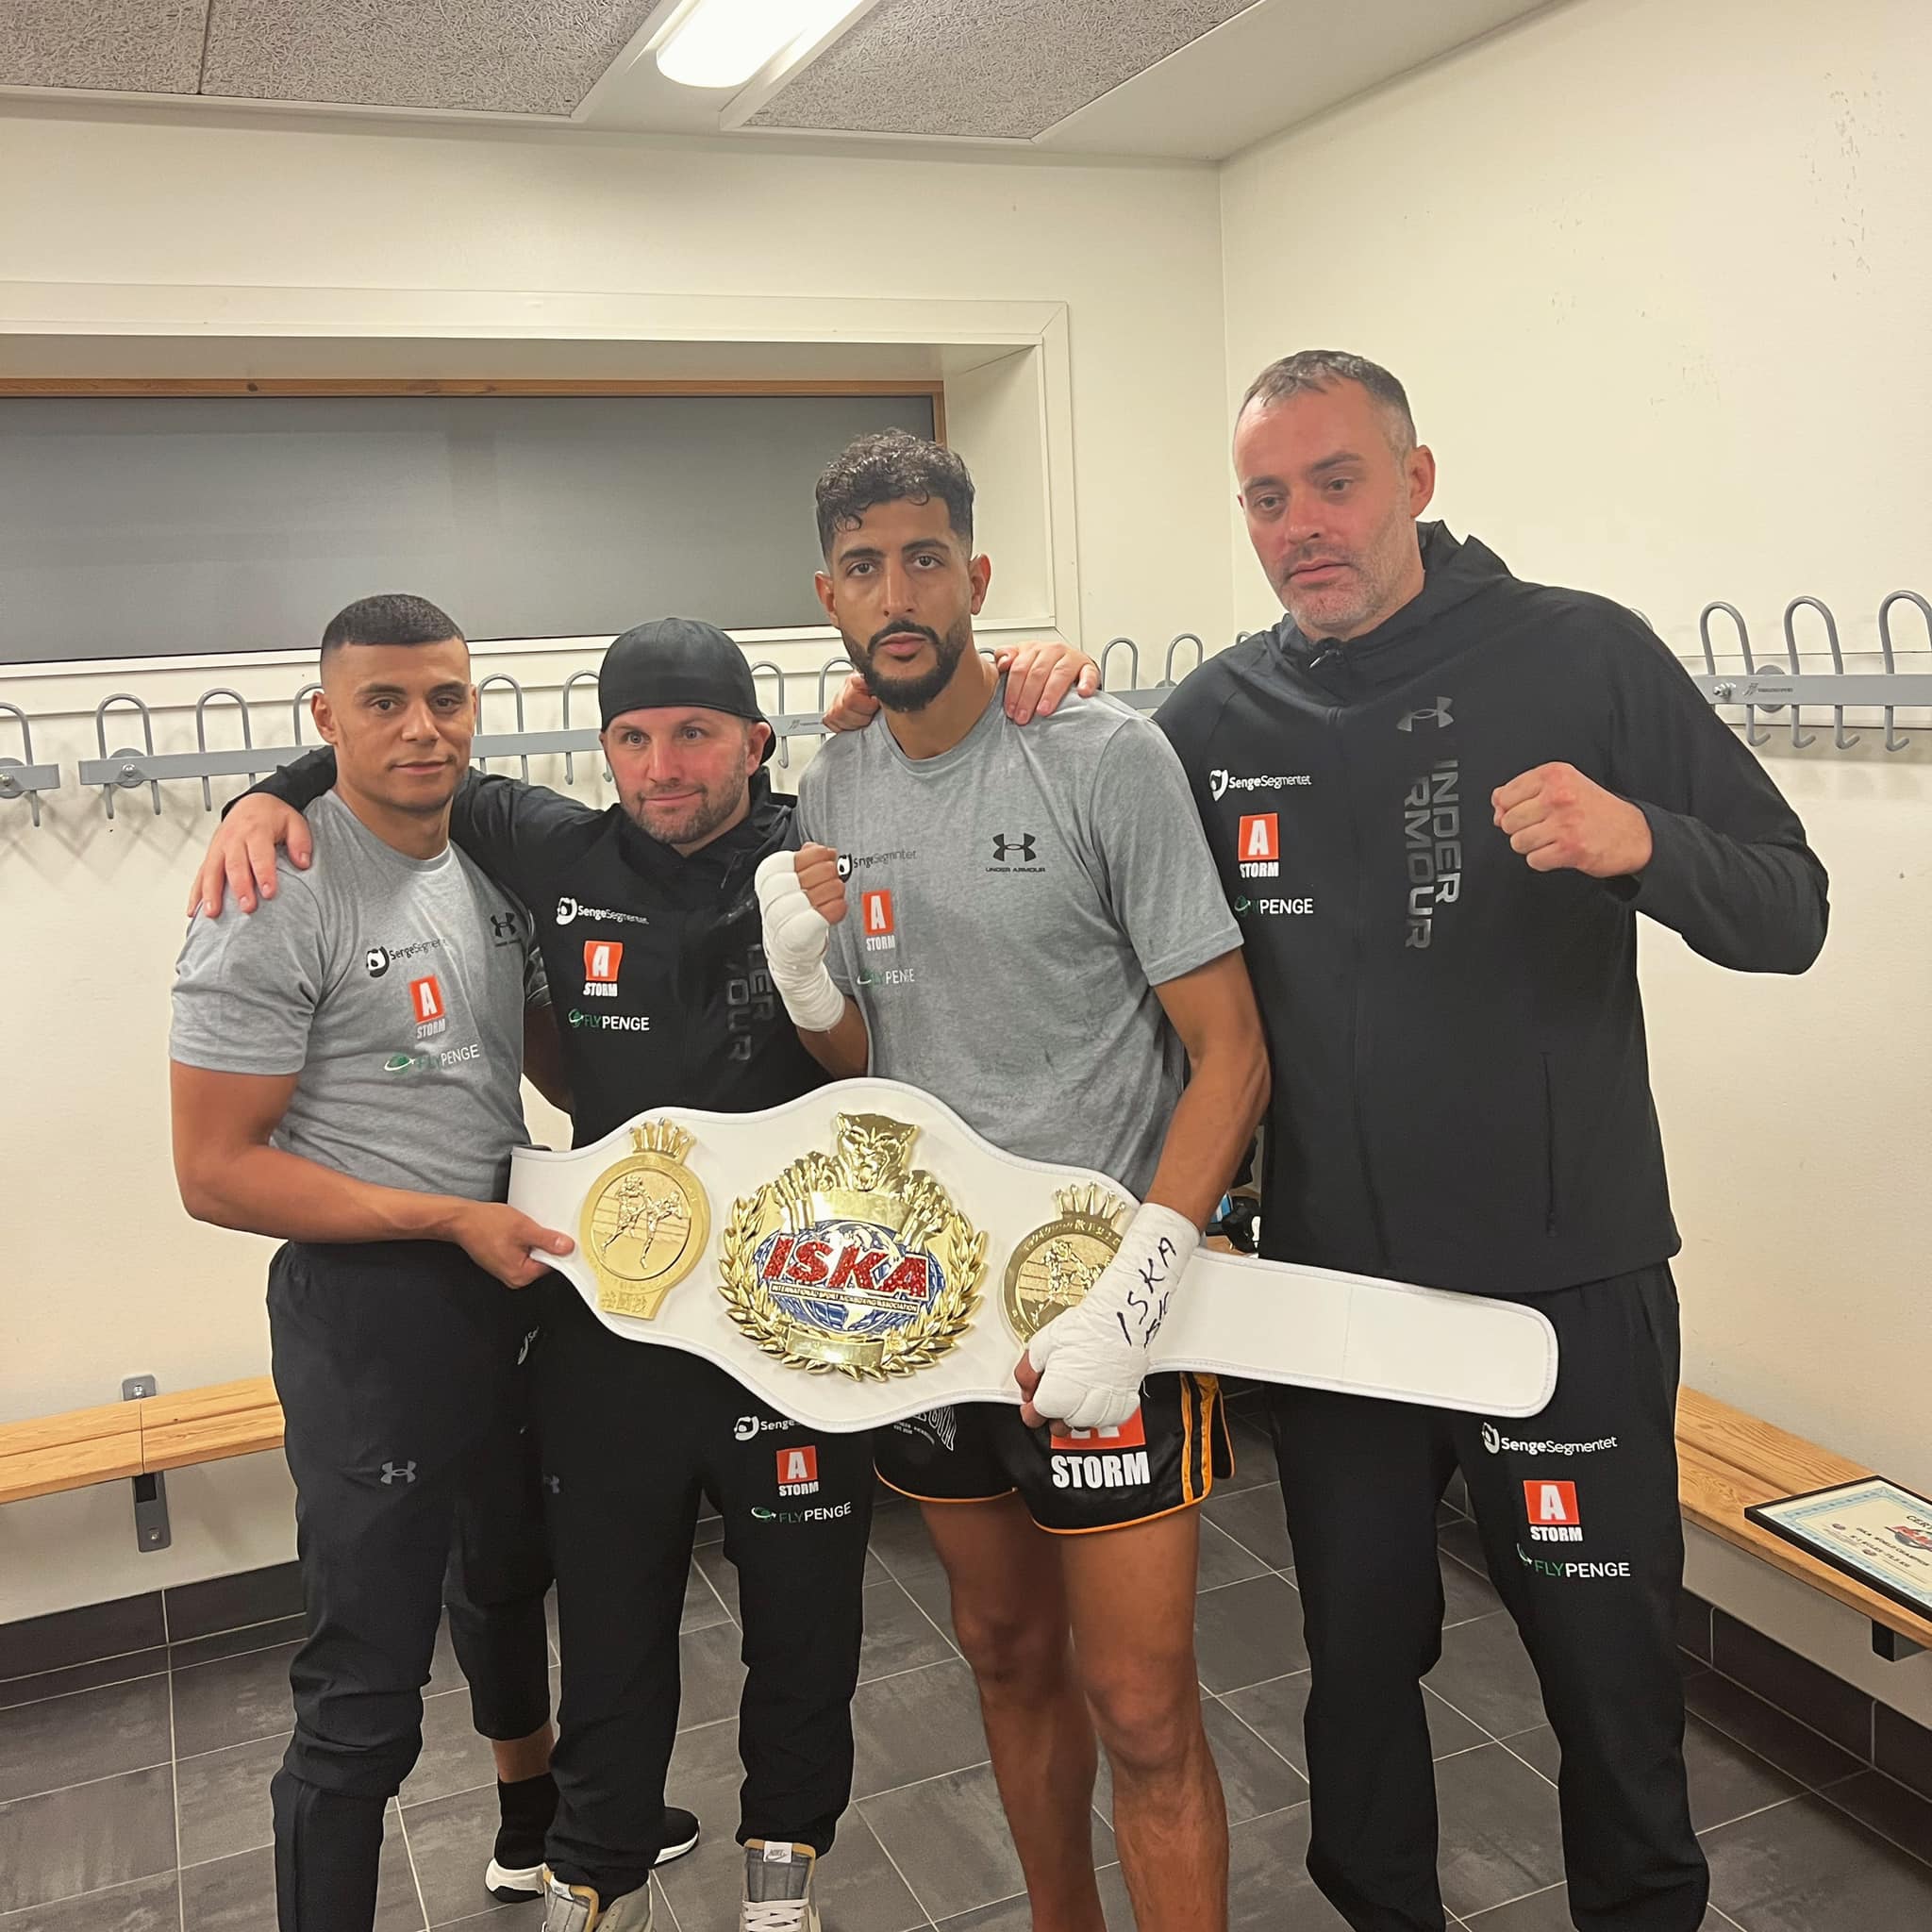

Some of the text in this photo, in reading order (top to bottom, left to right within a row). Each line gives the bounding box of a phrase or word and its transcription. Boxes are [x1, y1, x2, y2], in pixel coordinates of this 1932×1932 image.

[1228, 774, 1313, 791] SengeSegmentet
[1248, 819, 1270, 857] A
[1240, 861, 1279, 878] STORM
[1404, 775, 1434, 949] RMOUR
[871, 895, 887, 930] A
[866, 935, 896, 952] STORM
[592, 945, 610, 978] A
[419, 982, 439, 1017] A
[583, 983, 618, 997] STORM
[416, 1019, 446, 1040] STORM
[584, 1015, 650, 1031] FLYPENGE
[763, 1236, 930, 1299] ISKA
[1116, 1237, 1176, 1347] ISKA
[1501, 1436, 1619, 1457] SengeSegmentet
[787, 1451, 808, 1480] A
[1051, 1451, 1151, 1489] STORM
[778, 1481, 820, 1497] STORM
[778, 1502, 852, 1524] FLYPENGE
[1540, 1484, 1567, 1521] A
[1530, 1526, 1584, 1541] STORM
[1534, 1559, 1631, 1578] FLYPENGE
